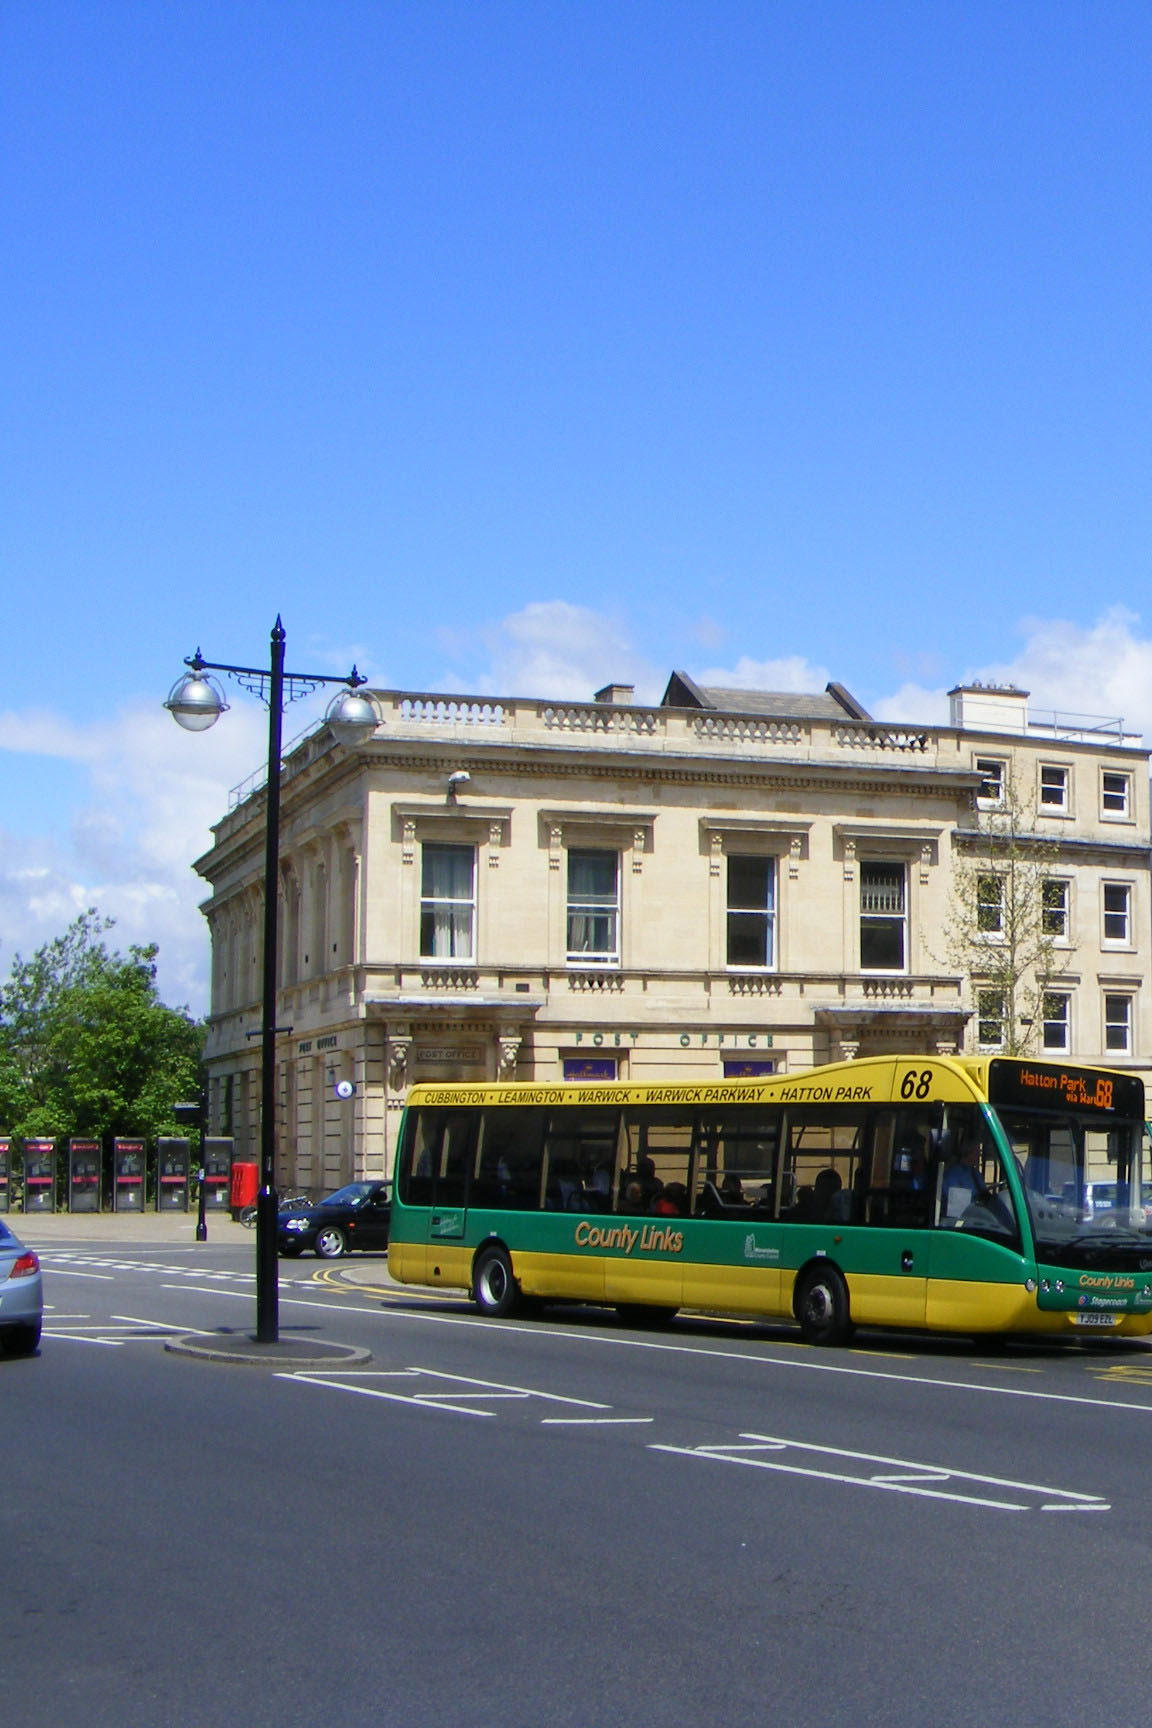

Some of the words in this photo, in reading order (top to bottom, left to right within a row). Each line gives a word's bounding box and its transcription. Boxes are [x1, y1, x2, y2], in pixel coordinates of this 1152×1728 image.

[576, 1032, 638, 1046] POST
[680, 1033, 773, 1047] OFFICE
[900, 1070, 933, 1099] 68
[1020, 1069, 1057, 1089] Hatton
[1060, 1074, 1087, 1092] Park
[424, 1092, 487, 1104] CUBBINGTON
[498, 1090, 565, 1104] LEAMINGTON
[578, 1090, 631, 1103] WARWICK
[645, 1088, 702, 1102] WARWICK
[703, 1088, 765, 1101] PARKWAY
[780, 1086, 833, 1101] HATTON
[834, 1086, 873, 1100] PARK
[1096, 1079, 1114, 1108] 68
[574, 1220, 639, 1254] County
[640, 1224, 685, 1253] Links
[1079, 1274, 1113, 1288] County
[1114, 1275, 1135, 1288] Links
